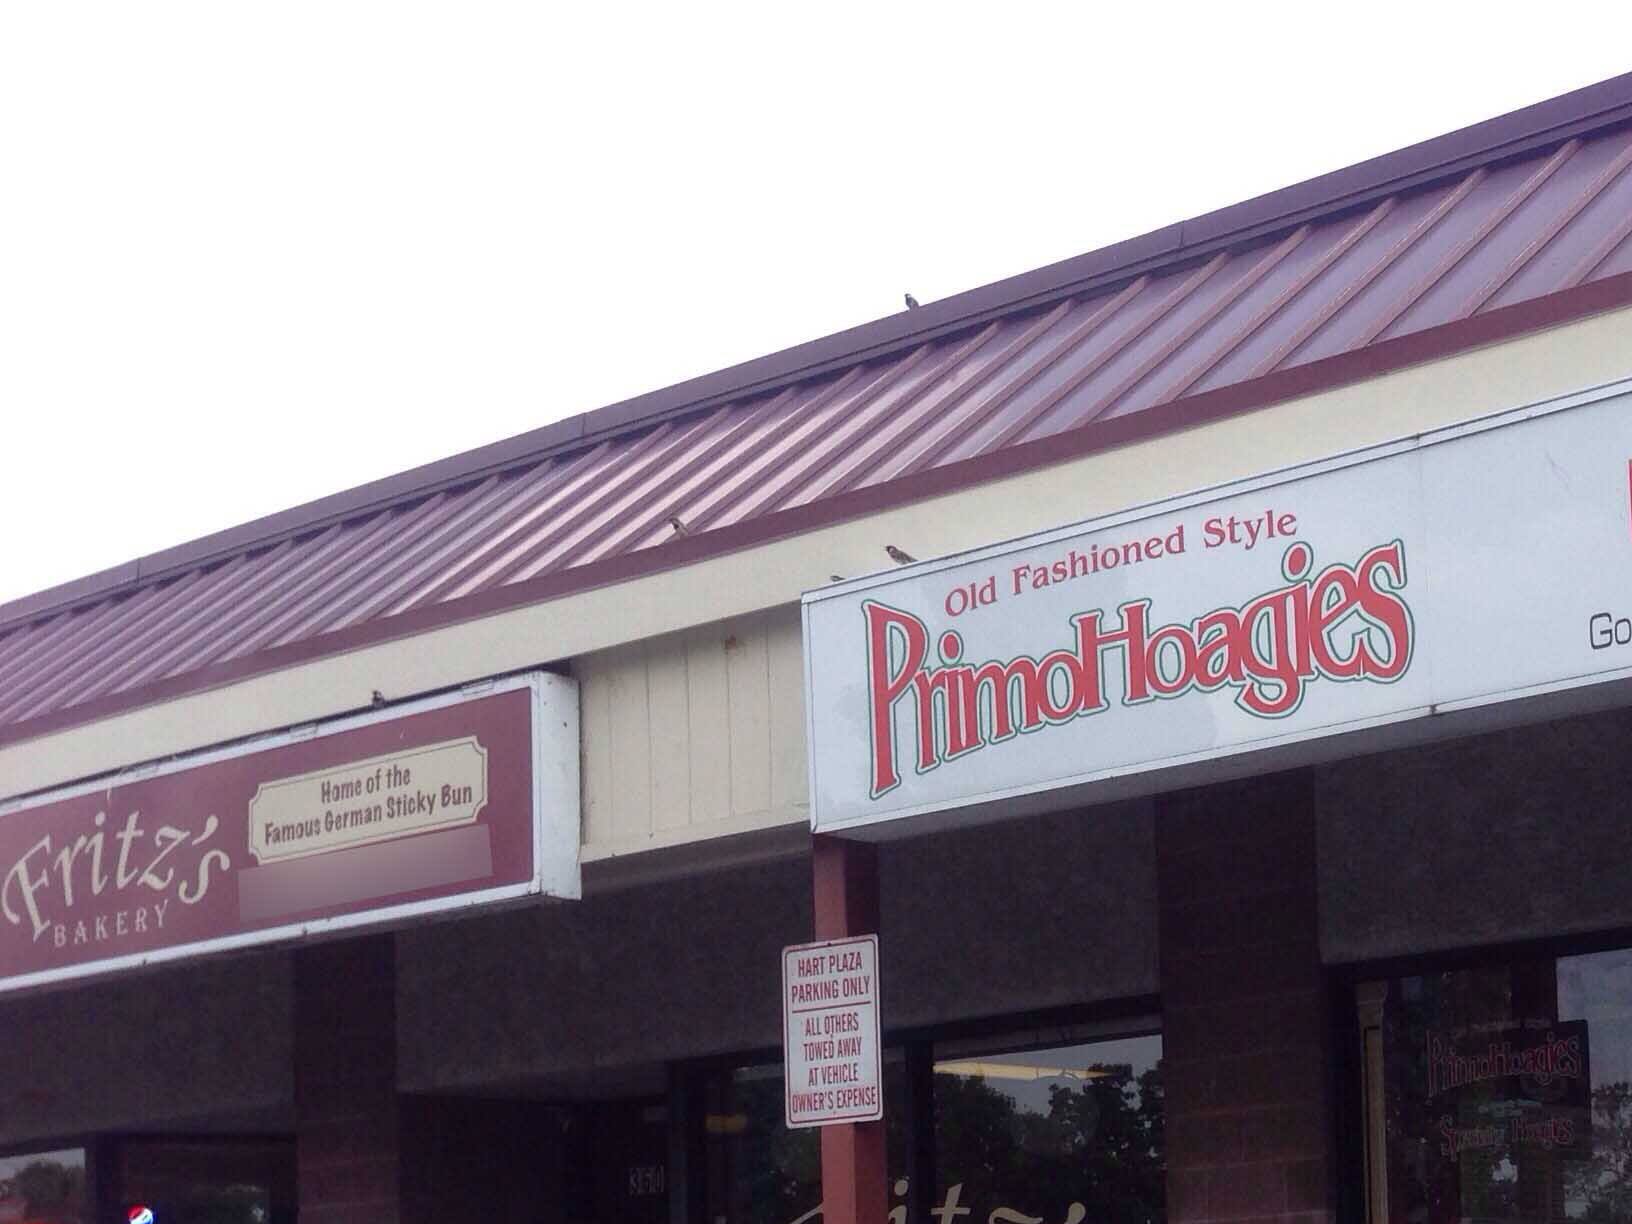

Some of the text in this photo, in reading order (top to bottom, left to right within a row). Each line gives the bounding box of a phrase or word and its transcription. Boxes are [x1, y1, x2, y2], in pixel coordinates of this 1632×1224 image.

[945, 509, 1297, 617] Old Fashioned Style
[862, 539, 1415, 799] PrimoHoagies
[321, 764, 411, 804] Home of the
[264, 783, 473, 845] Famous German Sticky Bun
[1, 809, 231, 943] Fritz's
[53, 900, 169, 948] BAKERY
[797, 952, 863, 977] HART PLAZA
[791, 975, 871, 1003] PARKING ONLY
[805, 1012, 859, 1037] ALL OTHERS
[803, 1037, 862, 1062] TOWED AWAY
[808, 1063, 859, 1087] AT VEHICLE
[792, 1086, 876, 1114] OWNER'S EXPENSE
